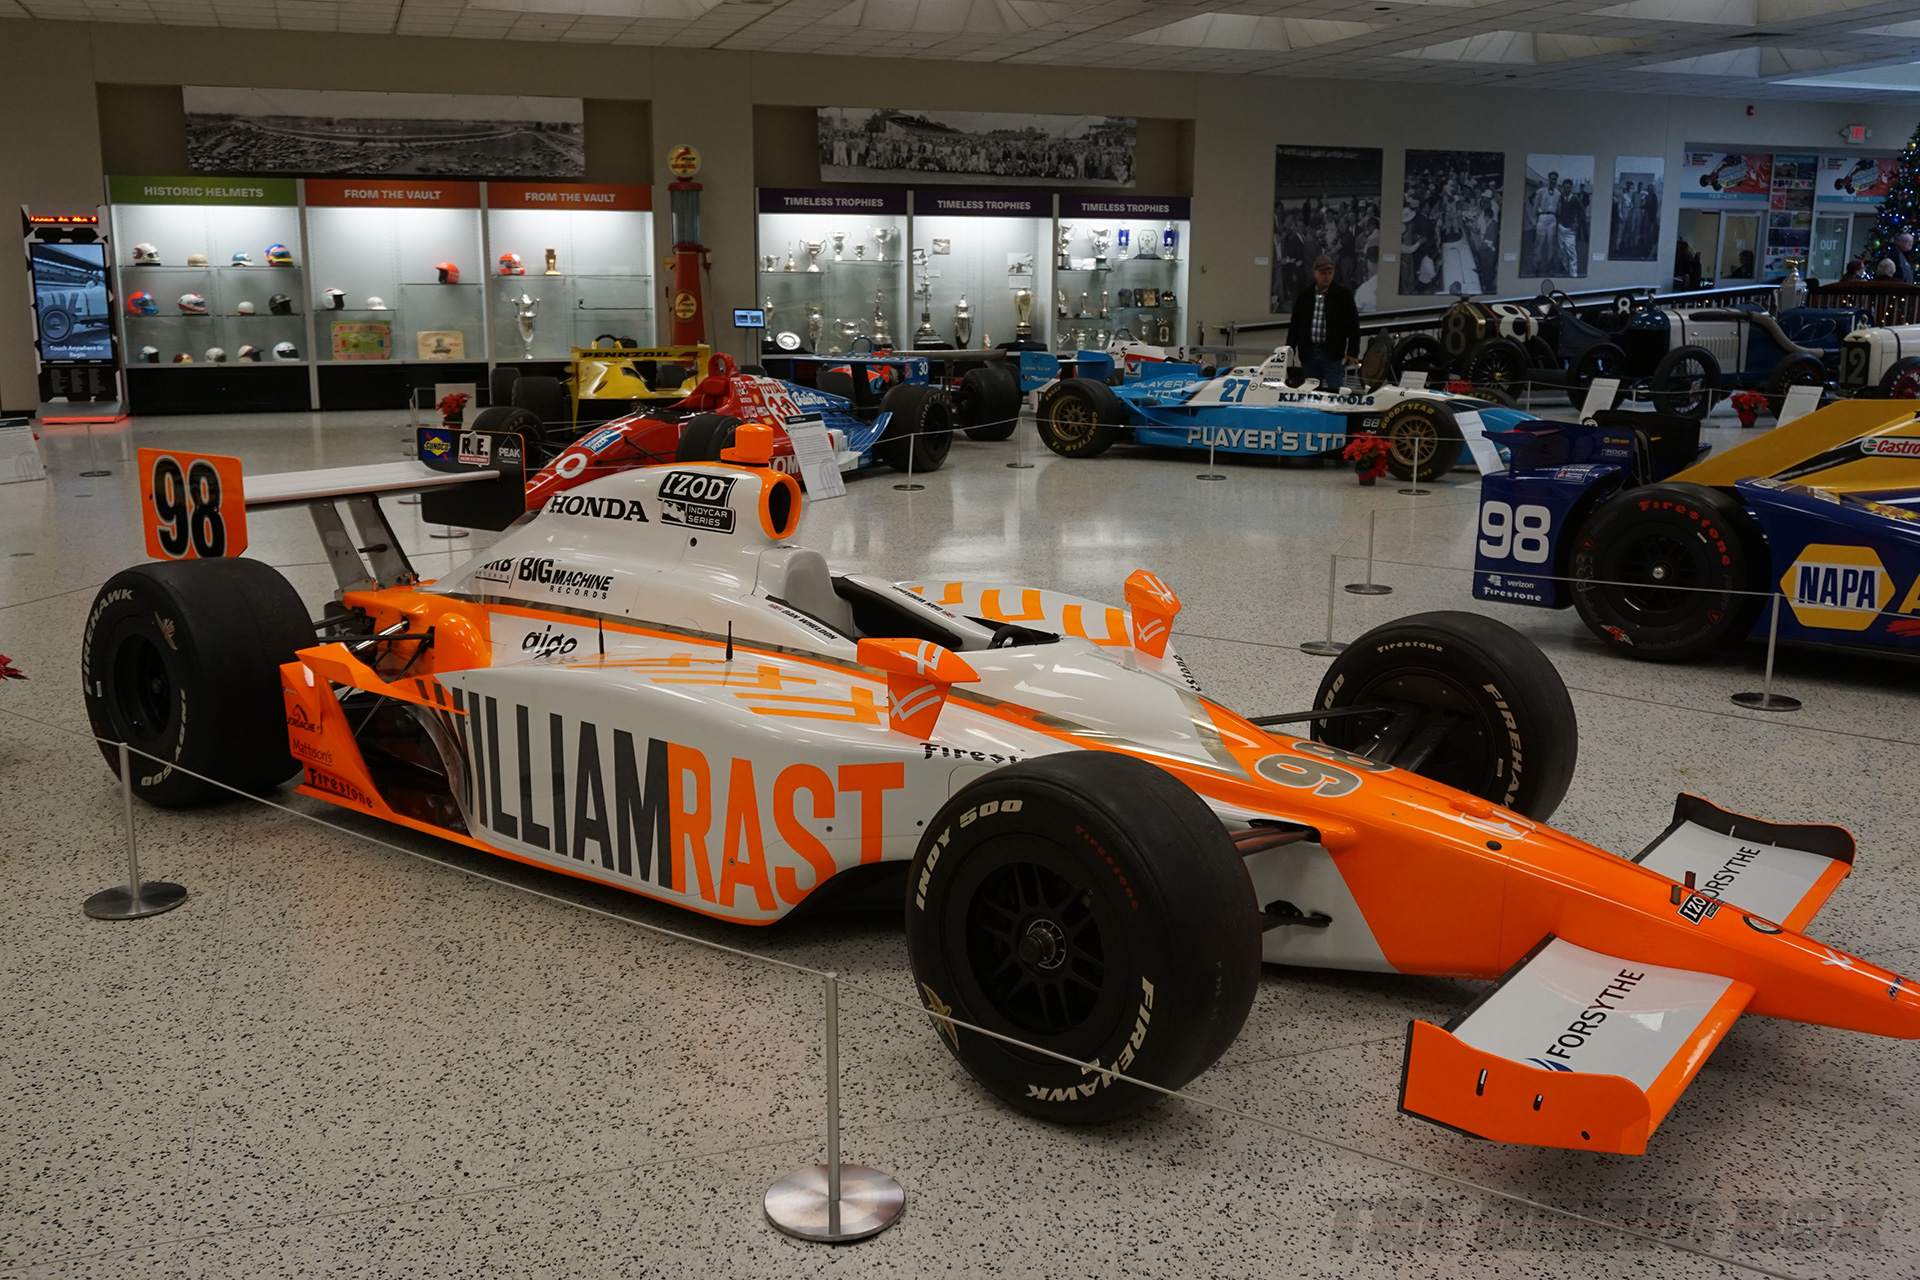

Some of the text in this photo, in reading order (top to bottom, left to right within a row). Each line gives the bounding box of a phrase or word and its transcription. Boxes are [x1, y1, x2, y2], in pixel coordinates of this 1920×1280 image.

[144, 186, 264, 198] HISTORIC HELMETS
[344, 189, 441, 200] FROM THE VAULT
[525, 192, 616, 203] FROM THE VAULT
[784, 197, 884, 207] TIMELESS TROPHIES
[937, 200, 1031, 210] TIMELESS TROPHIES
[1081, 203, 1170, 213] TIMELESS TROPHIES
[1820, 240, 1838, 251] OUT
[1445, 311, 1467, 356] 8
[1178, 347, 1185, 360] 5
[918, 362, 928, 376] 30
[1839, 347, 1867, 385] 12
[759, 382, 787, 394] TOTAL
[1131, 380, 1196, 389] PLAYER'S
[1219, 378, 1250, 403] 27
[1278, 393, 1375, 405] KLEIN TOOLS
[1381, 402, 1435, 430] GOODYEAR
[424, 442, 451, 450] SUNOCO
[1187, 426, 1299, 451] PLAYER'S
[499, 447, 521, 458] PEAK
[661, 472, 725, 500] IZOD
[152, 455, 225, 558] 98
[549, 495, 649, 523] HONDA
[688, 505, 728, 519] INDYCAR
[687, 515, 721, 528] SERIES
[1479, 501, 1552, 565] 98
[1637, 500, 1731, 567] Firestone
[518, 557, 614, 592] BIG MACHINE
[1507, 580, 1535, 589] verizon
[549, 585, 607, 600] RECORDS
[1483, 586, 1542, 602] Firestone
[1799, 566, 1875, 609] NAPA
[781, 609, 838, 640] DAN WHELDON
[82, 588, 133, 696] FIREHAWK
[1376, 640, 1444, 653] Firestone
[293, 738, 333, 764] Mattison's
[308, 767, 373, 808] Firestone
[915, 800, 1024, 912] INDY 500
[1074, 824, 1139, 911] Firestone
[1545, 968, 1646, 1060] FORSYTHE
[1025, 975, 1155, 1102] FIREHAWK
